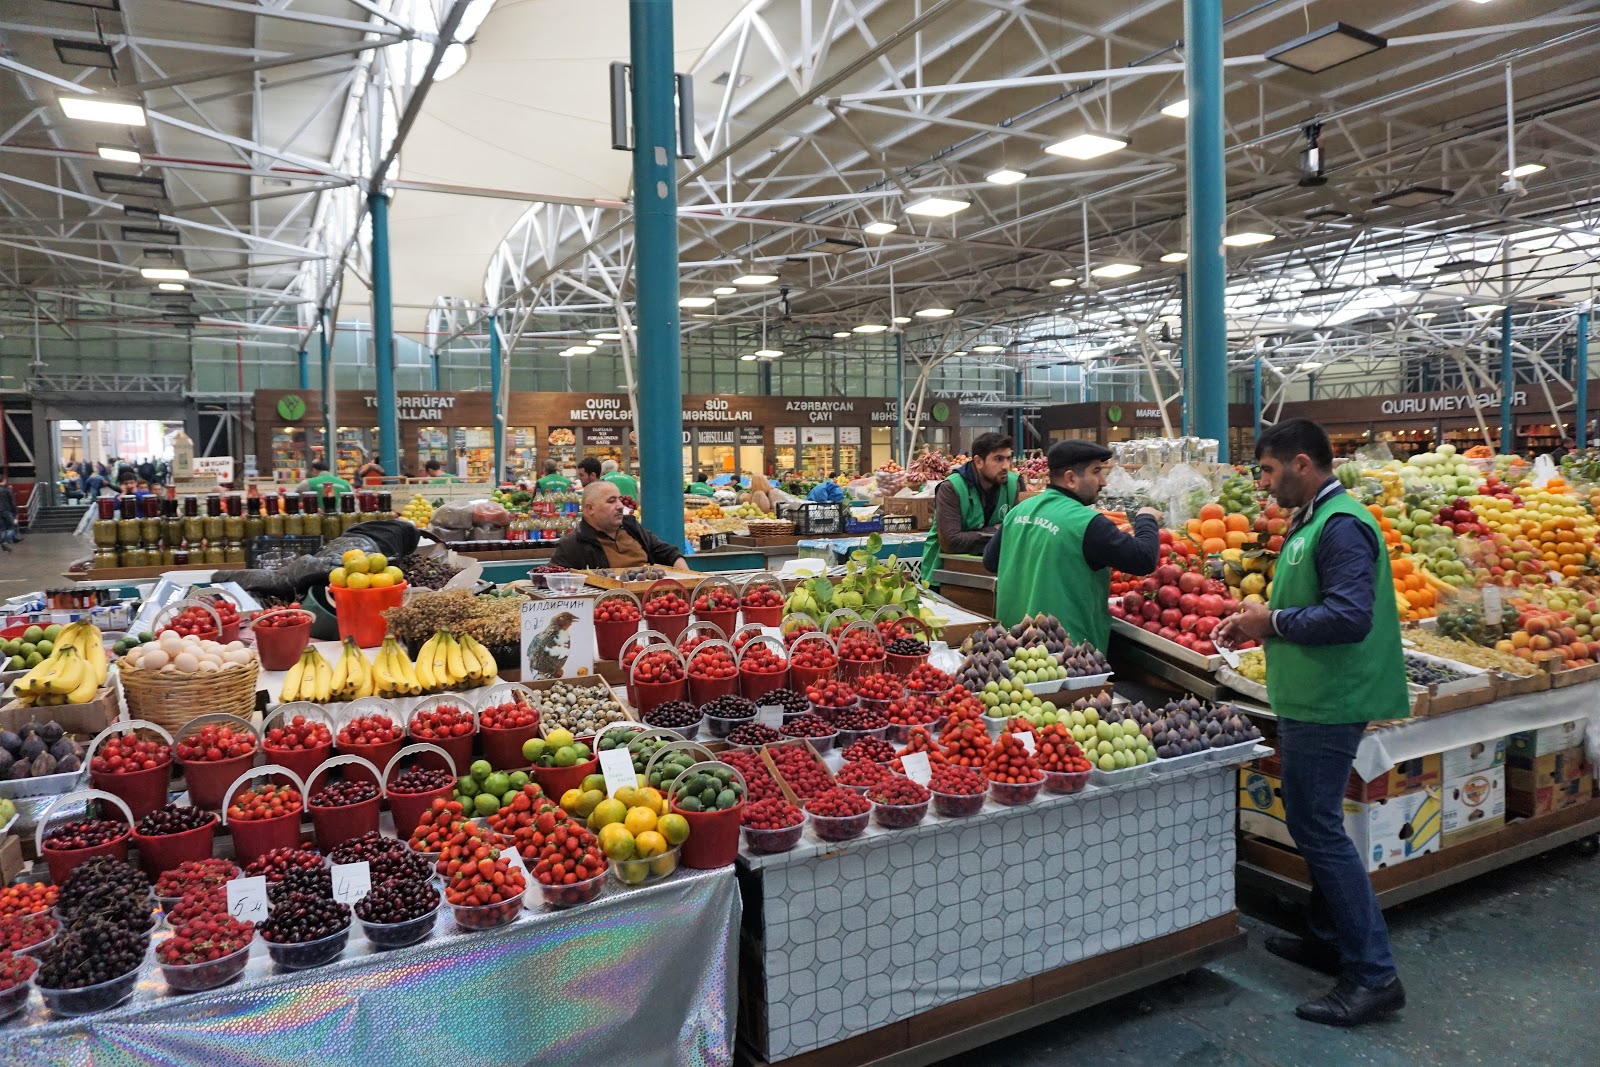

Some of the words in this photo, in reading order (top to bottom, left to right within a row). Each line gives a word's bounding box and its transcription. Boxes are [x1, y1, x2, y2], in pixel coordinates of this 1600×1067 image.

[364, 394, 455, 408] TƏƏRRÜFAT
[586, 399, 620, 409] QURU
[706, 398, 728, 410] SÜD
[786, 402, 853, 411] AZƏRBAYCAN
[1381, 398, 1426, 414] QURU
[1430, 391, 1527, 411] MEYVƏLR
[397, 409, 442, 420] ALLARI
[682, 411, 753, 420] MƏHSULLARI
[809, 412, 832, 423] ÇAYI
[1135, 409, 1162, 418] MARKE
[522, 600, 584, 613] БИЛДИРЧИН
[233, 896, 248, 917] 5
